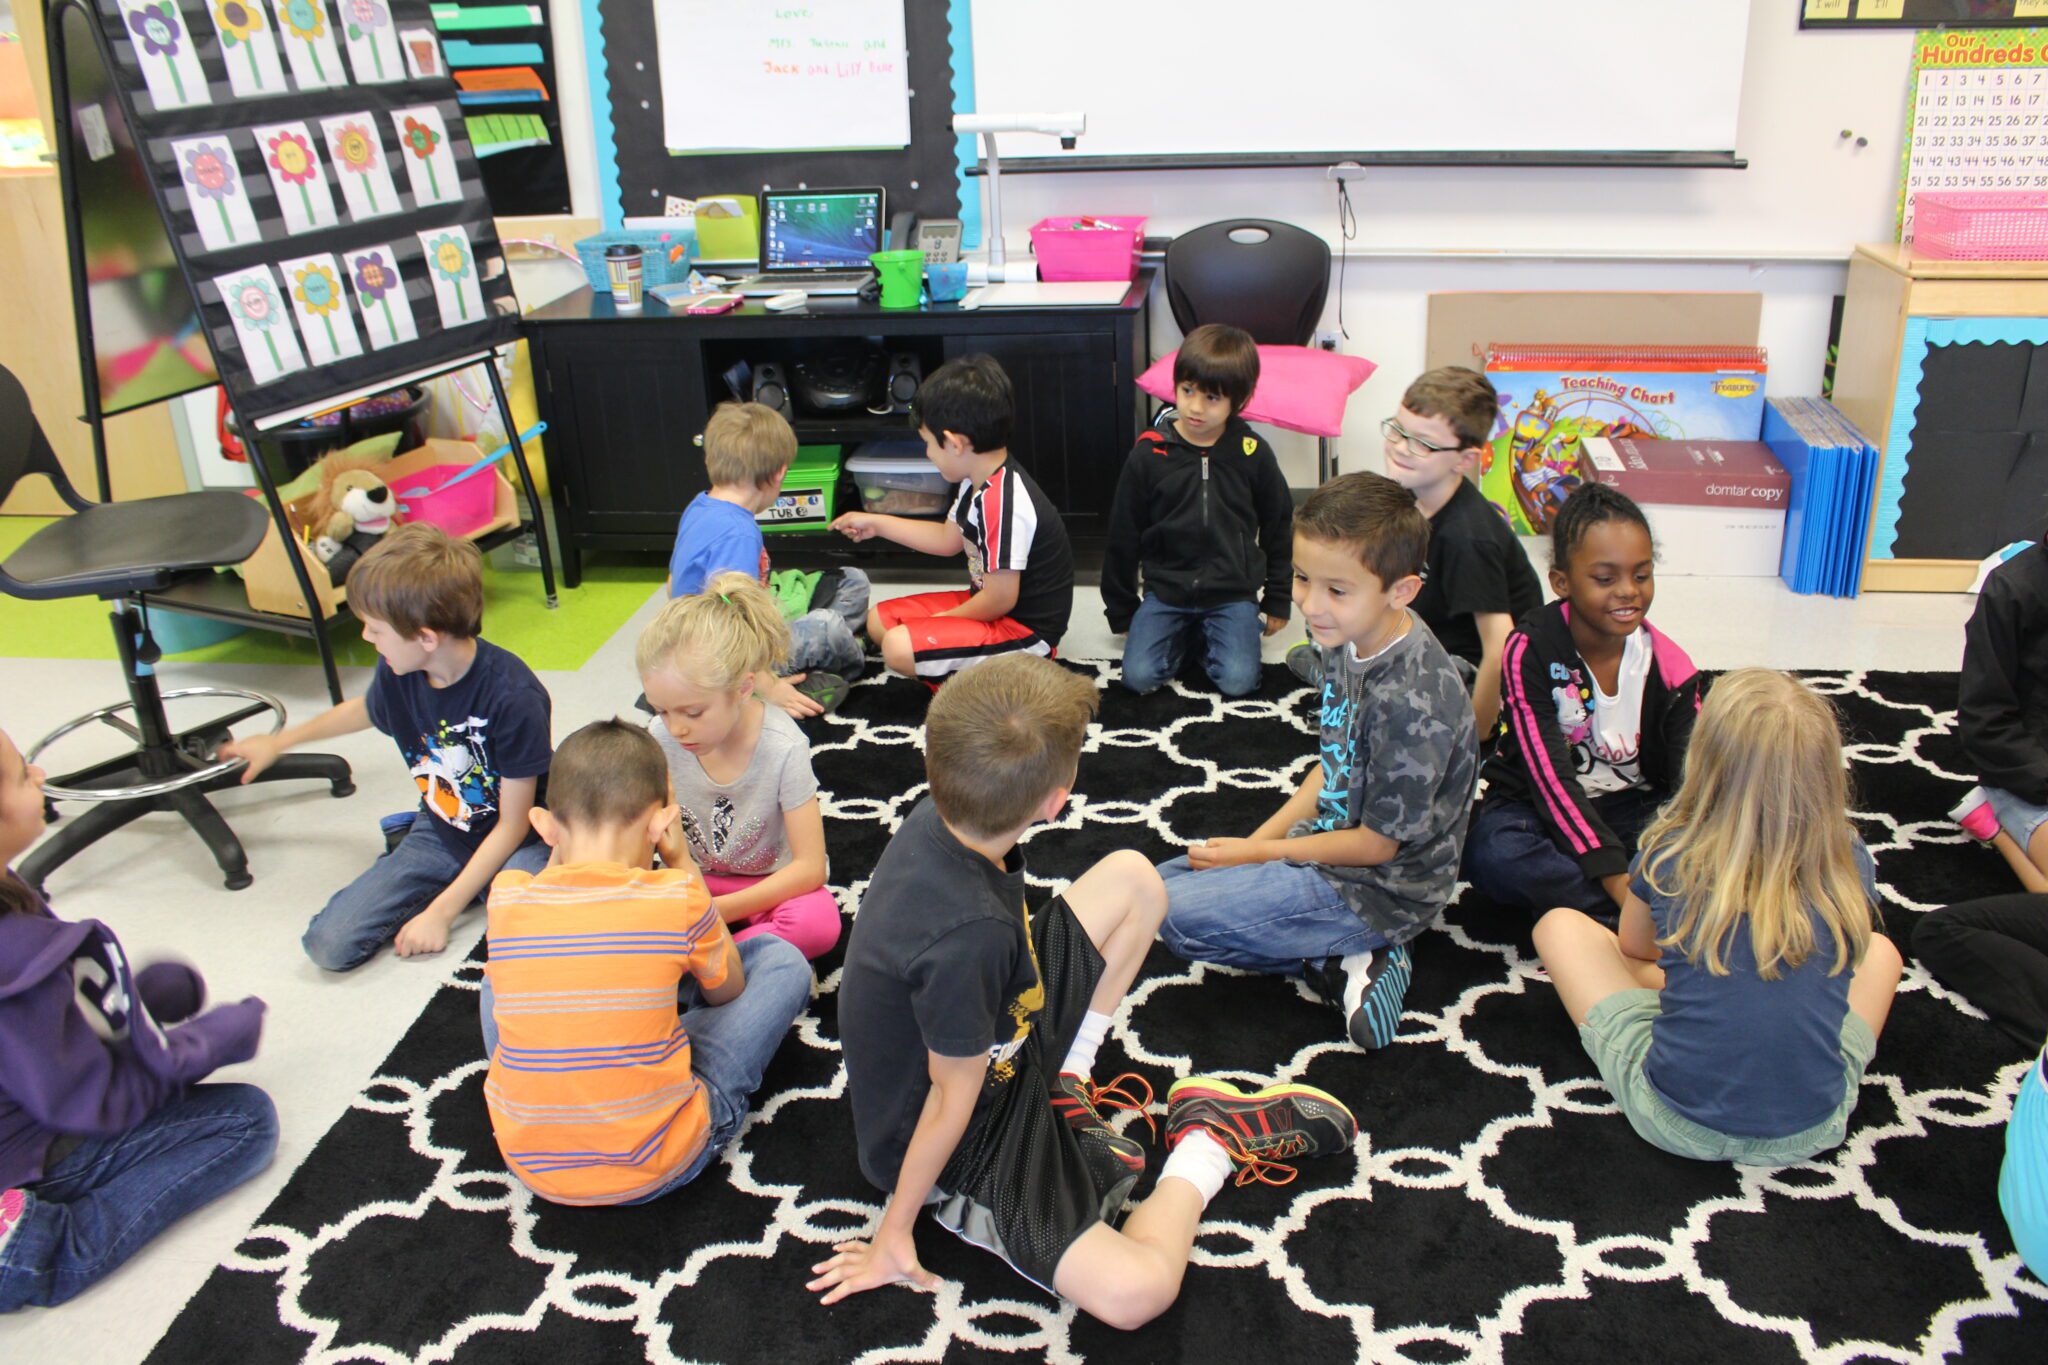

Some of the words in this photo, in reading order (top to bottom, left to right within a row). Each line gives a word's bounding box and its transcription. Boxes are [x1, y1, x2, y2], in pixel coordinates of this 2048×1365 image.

[1947, 34, 1976, 47] Our
[1922, 43, 2034, 65] Hundreds
[1942, 75, 1949, 86] 2
[1960, 75, 1968, 86] 3
[1978, 75, 1985, 86] 4
[1996, 75, 2004, 86] 5
[2014, 75, 2023, 86] 6
[2033, 75, 2042, 86] 7
[1920, 95, 1929, 106] 11
[1938, 95, 1948, 106] 12
[1956, 95, 1966, 106] 13
[1973, 95, 1984, 106] 14
[1992, 95, 2003, 106] 15
[2010, 95, 2021, 106] 16
[2028, 95, 2040, 106] 17
[1917, 115, 1928, 127] 21
[1934, 115, 1947, 127] 22
[1952, 115, 1966, 127] 23
[1970, 115, 1984, 127] 24
[1988, 115, 2002, 127] 25
[2006, 115, 2020, 127] 26
[2024, 115, 2039, 127] 27
[1915, 136, 1926, 147] 31
[1932, 136, 1945, 147] 32
[1950, 136, 1963, 147] 33
[1967, 136, 1981, 147] 34
[1986, 136, 1999, 147] 35
[2003, 136, 2018, 147] 36
[2022, 136, 2036, 147] 37
[1913, 156, 1924, 167] 41
[1929, 156, 1943, 167] 42
[1947, 156, 1961, 167] 43
[1964, 156, 1979, 167] 44
[1982, 156, 1997, 167] 45
[2000, 156, 2015, 167] 46
[2019, 156, 2033, 167] 47
[1911, 176, 1921, 187] 51
[1927, 176, 1940, 187] 52
[1945, 176, 1958, 187] 53
[1962, 176, 1976, 187] 54
[1980, 176, 1993, 187] 55
[1997, 176, 2011, 187] 56
[2015, 176, 2030, 187] 57
[2033, 176, 2048, 187] 58
[1561, 377, 1627, 399] Teaching
[1630, 387, 1675, 405] Chart
[1711, 380, 1758, 394] Treasures
[1706, 483, 1748, 496] domtar
[1751, 485, 1784, 501] copy
[769, 508, 793, 519] TUB
